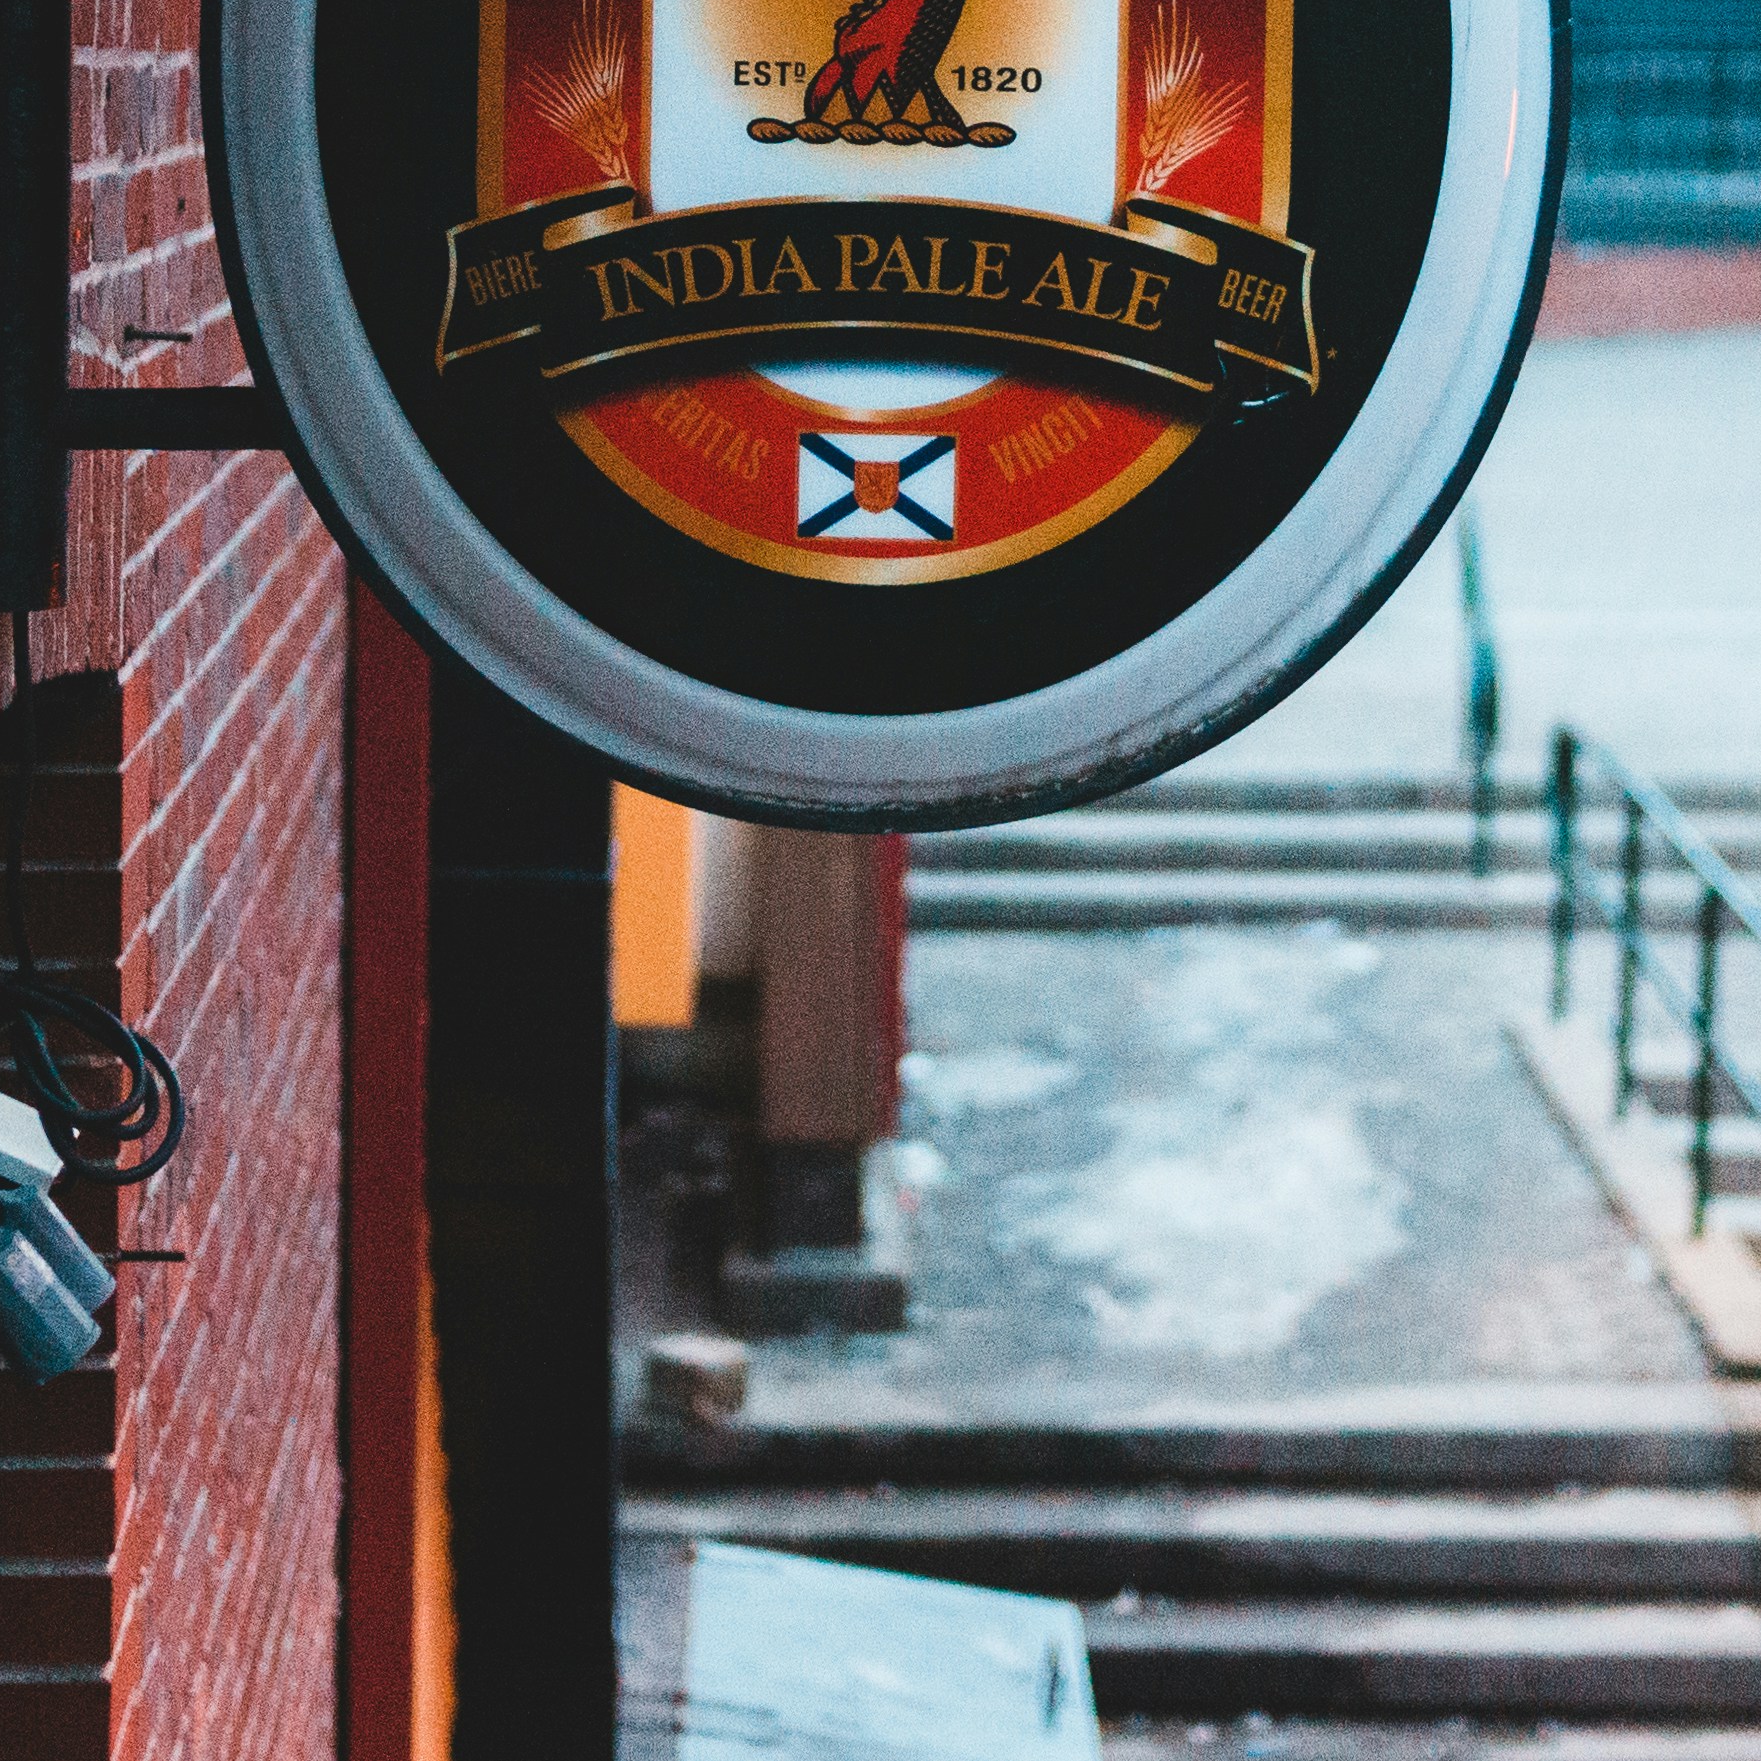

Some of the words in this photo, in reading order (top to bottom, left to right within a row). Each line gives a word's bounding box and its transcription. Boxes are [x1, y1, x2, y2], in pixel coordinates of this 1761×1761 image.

[951, 65, 1042, 93] 1820
[587, 238, 821, 322] INDIA
[834, 234, 1012, 299] PALE
[1022, 250, 1171, 331] ALE
[1218, 268, 1288, 324] BEER
[642, 386, 769, 480] ERITAS
